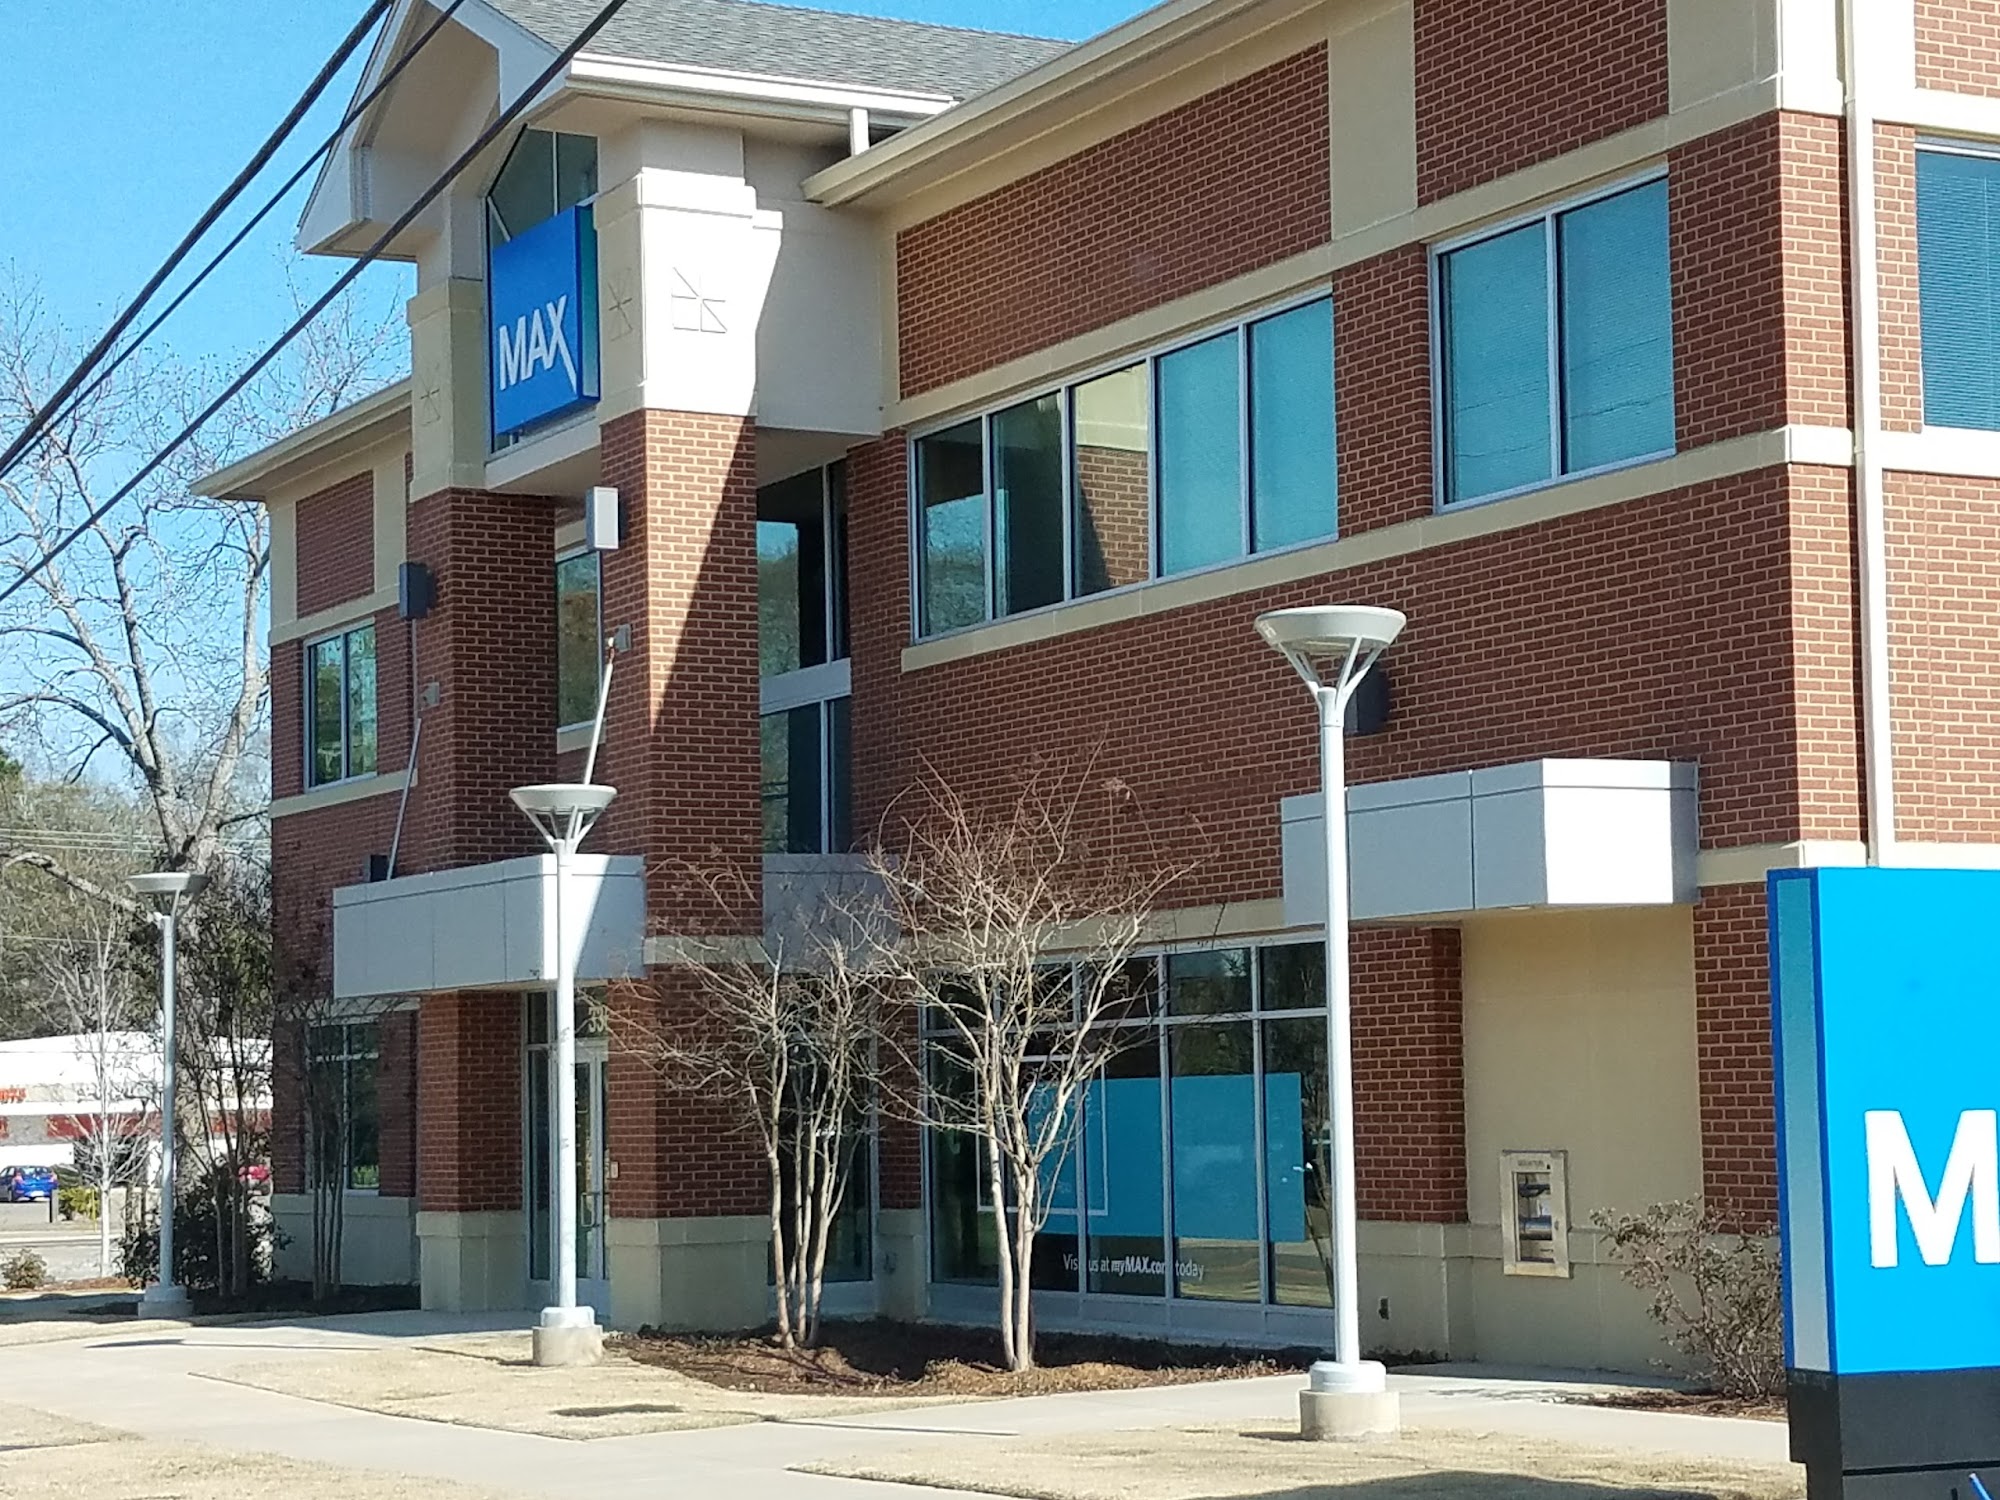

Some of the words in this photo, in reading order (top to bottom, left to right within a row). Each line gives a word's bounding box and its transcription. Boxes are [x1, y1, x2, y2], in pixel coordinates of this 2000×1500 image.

[499, 294, 578, 397] MAX
[1062, 1252, 1080, 1271] Vis
[1088, 1258, 1099, 1272] us
[1100, 1256, 1110, 1272] at
[1175, 1259, 1205, 1281] today
